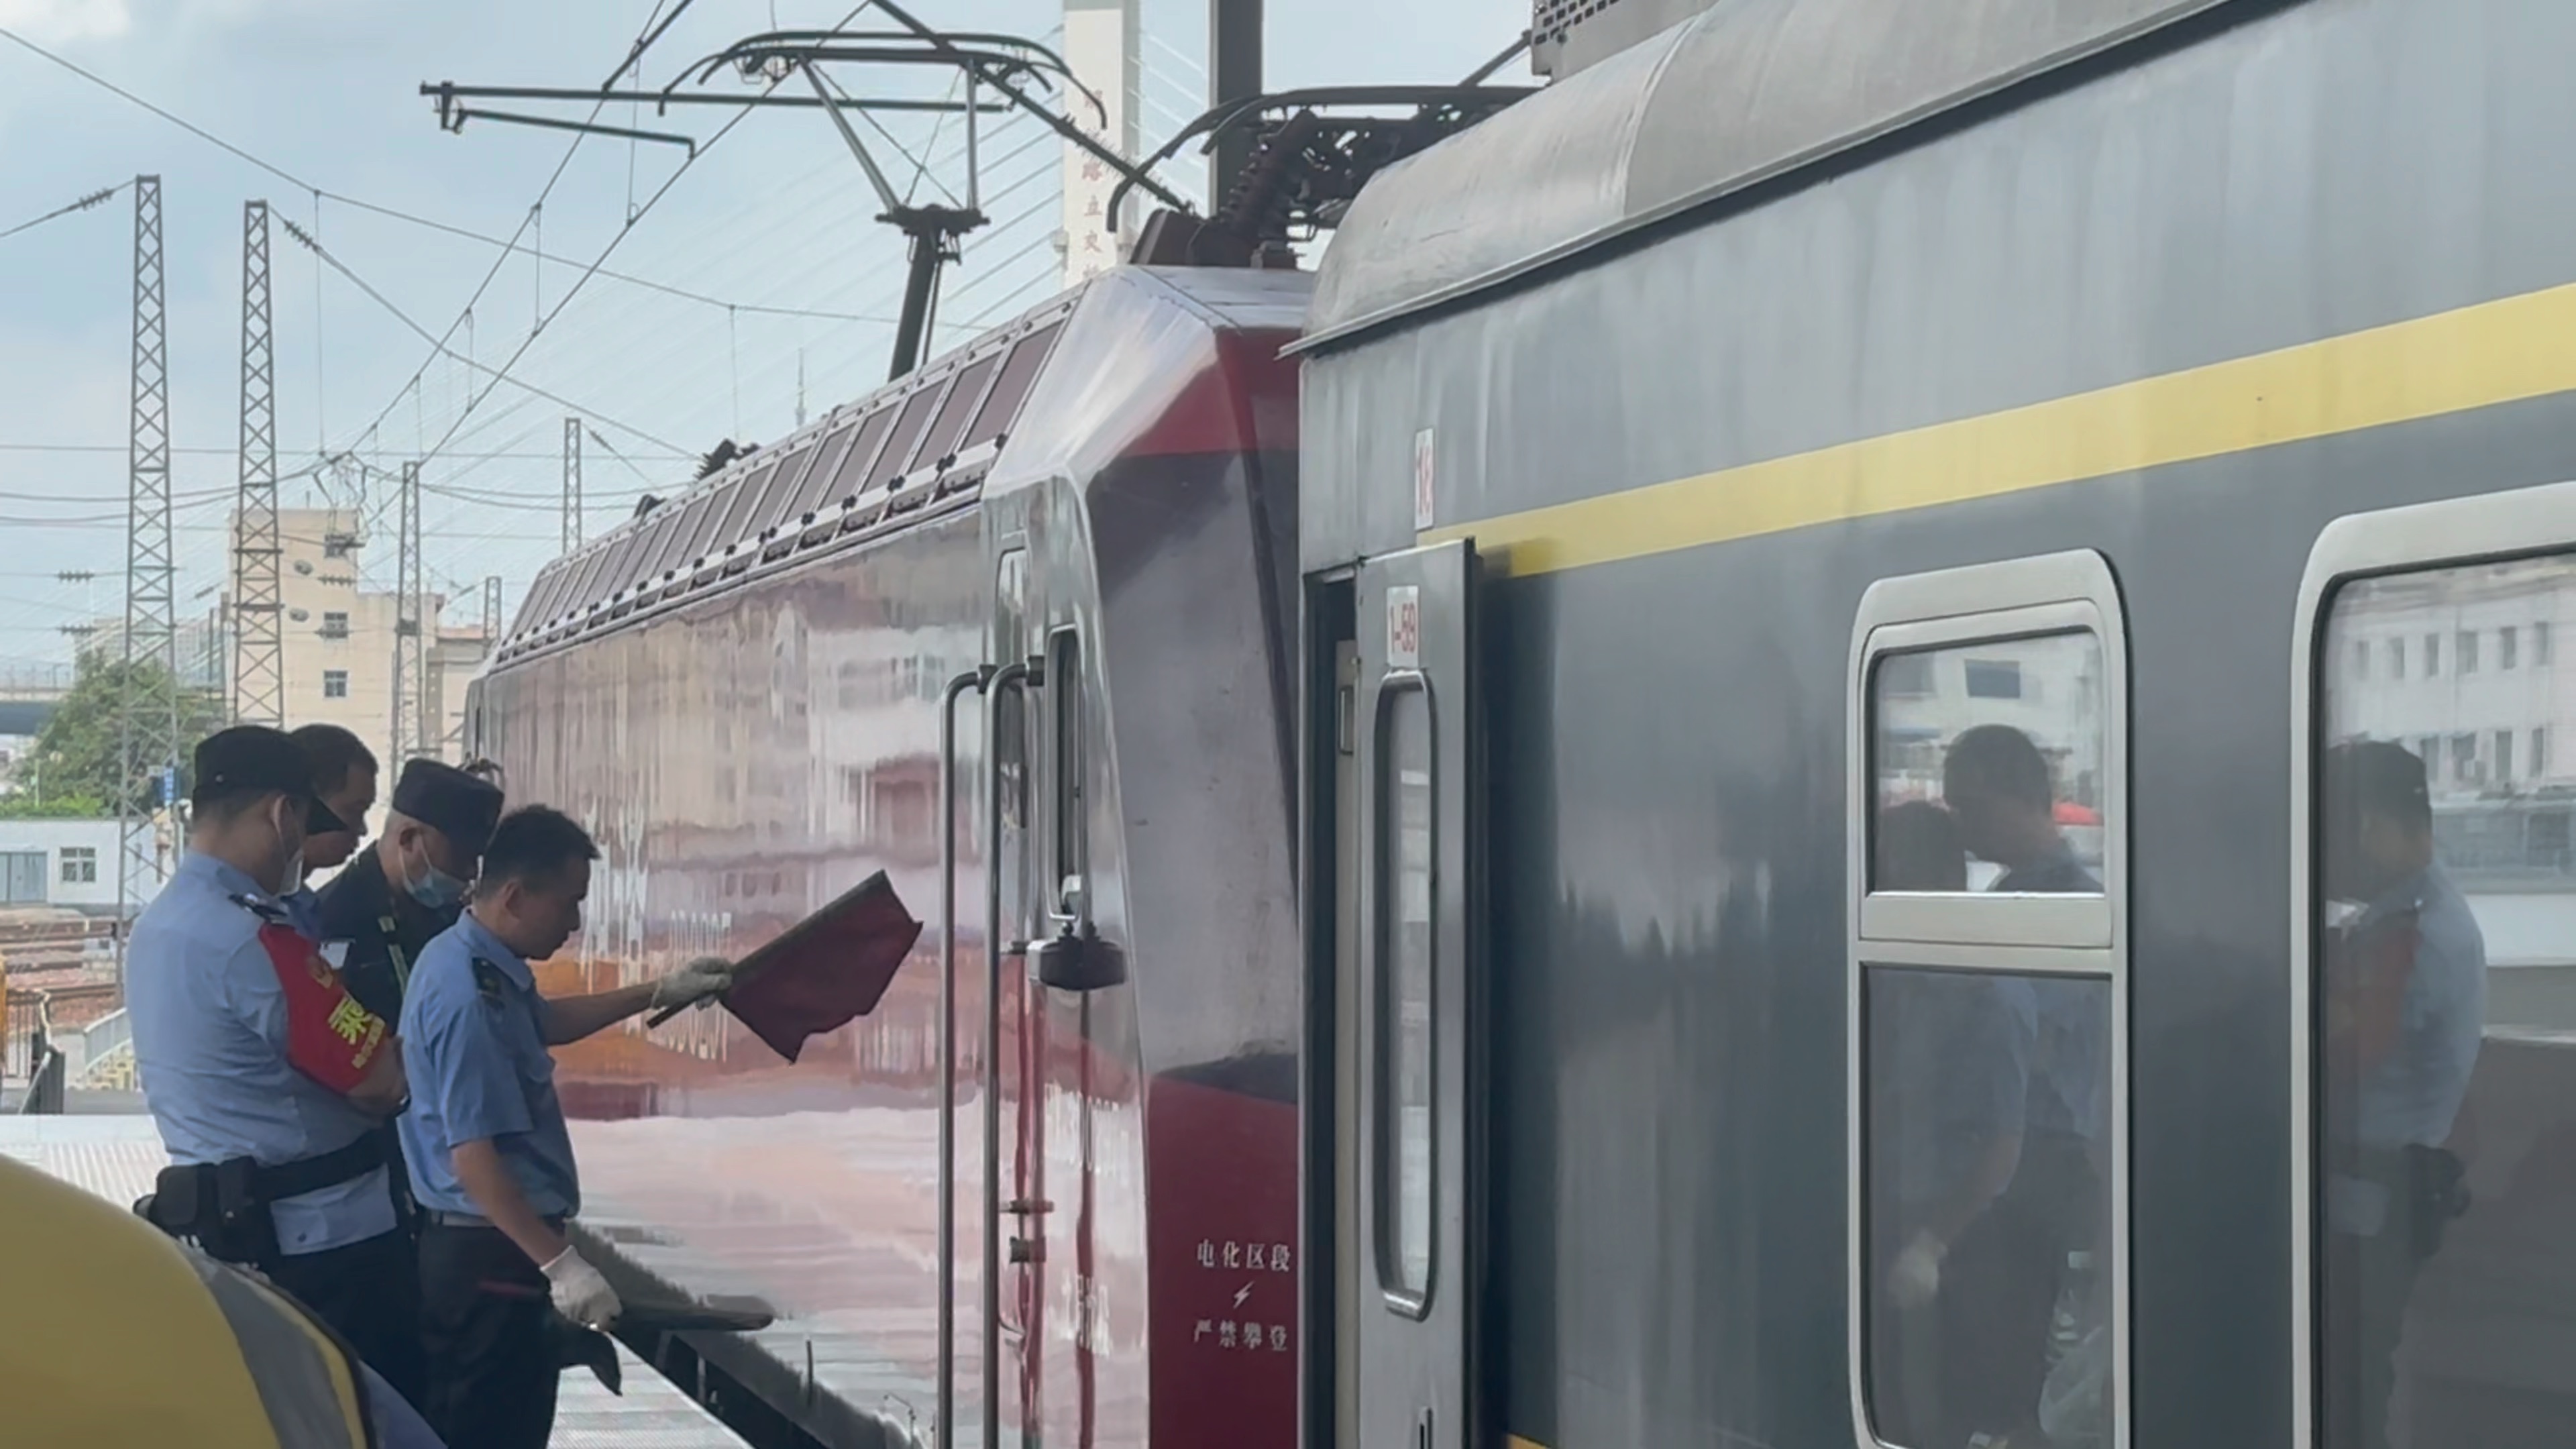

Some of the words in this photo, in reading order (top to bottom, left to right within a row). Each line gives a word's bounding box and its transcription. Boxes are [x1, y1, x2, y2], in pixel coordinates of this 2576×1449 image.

[1197, 1238, 1291, 1273] 电化区段
[1193, 1319, 1288, 1352] 严禁攀登
